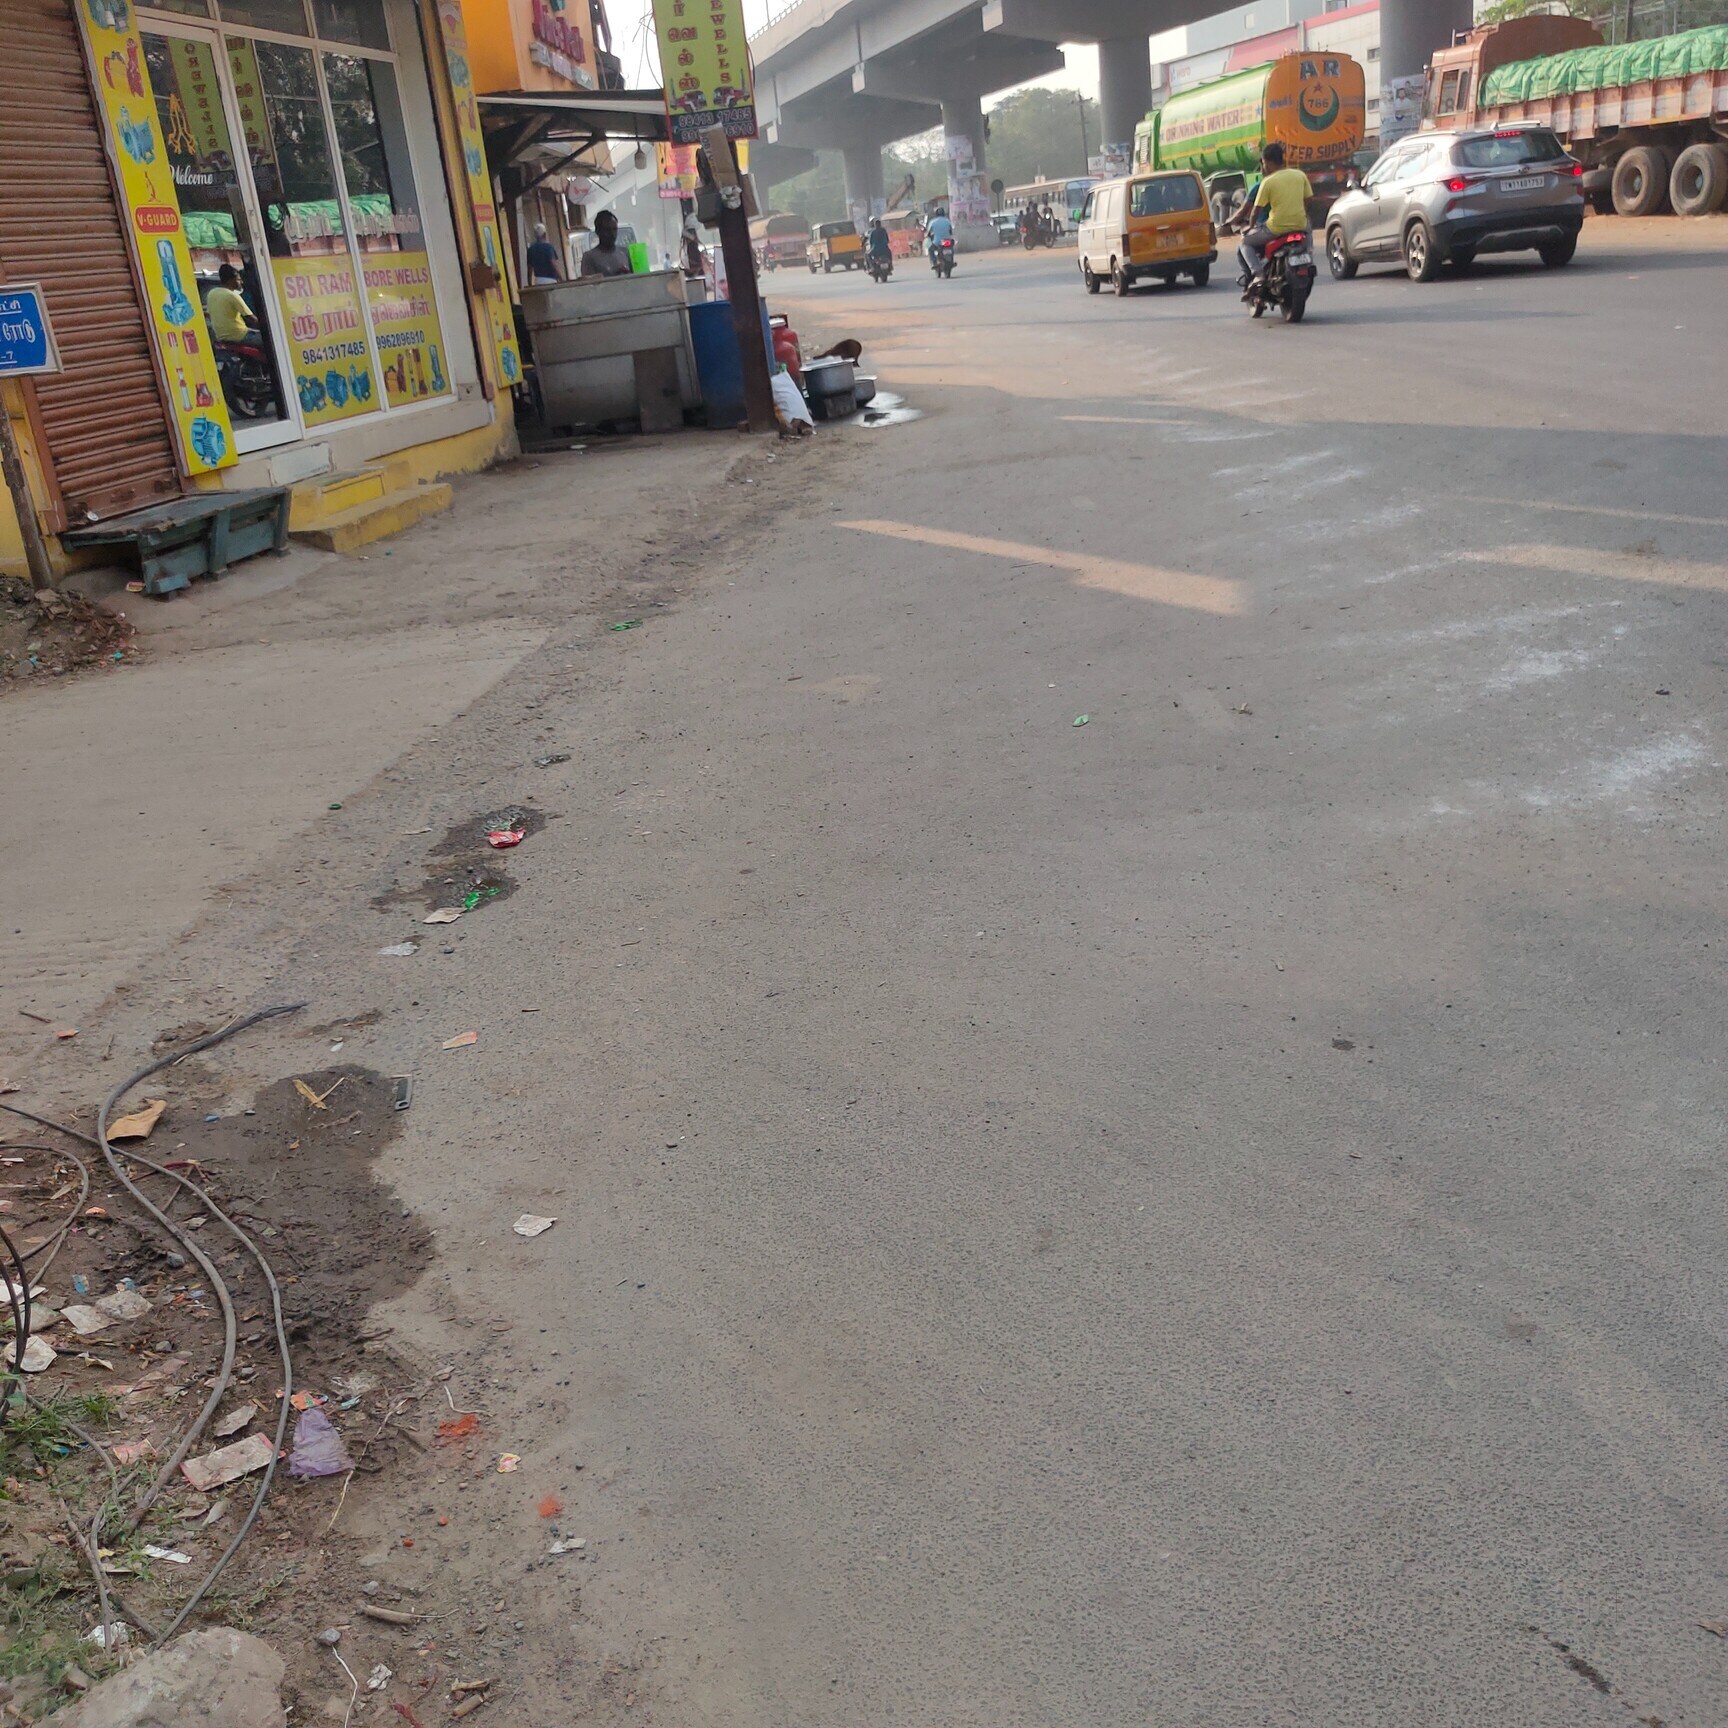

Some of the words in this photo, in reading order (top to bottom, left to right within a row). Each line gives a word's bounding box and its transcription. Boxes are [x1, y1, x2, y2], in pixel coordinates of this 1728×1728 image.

[678, 110, 714, 128] 98413
[717, 106, 752, 122] 17485
[1206, 109, 1240, 132] WATER
[725, 122, 755, 137] 6910
[1317, 135, 1357, 159] SUPPLY
[137, 214, 177, 226] V-GUARD
[285, 275, 313, 299] SRI
[317, 272, 353, 295] RAM
[364, 269, 394, 287] BORE
[395, 267, 428, 285] WELLS
[302, 341, 366, 365] 9841317485
[376, 330, 425, 350] 9962896910
